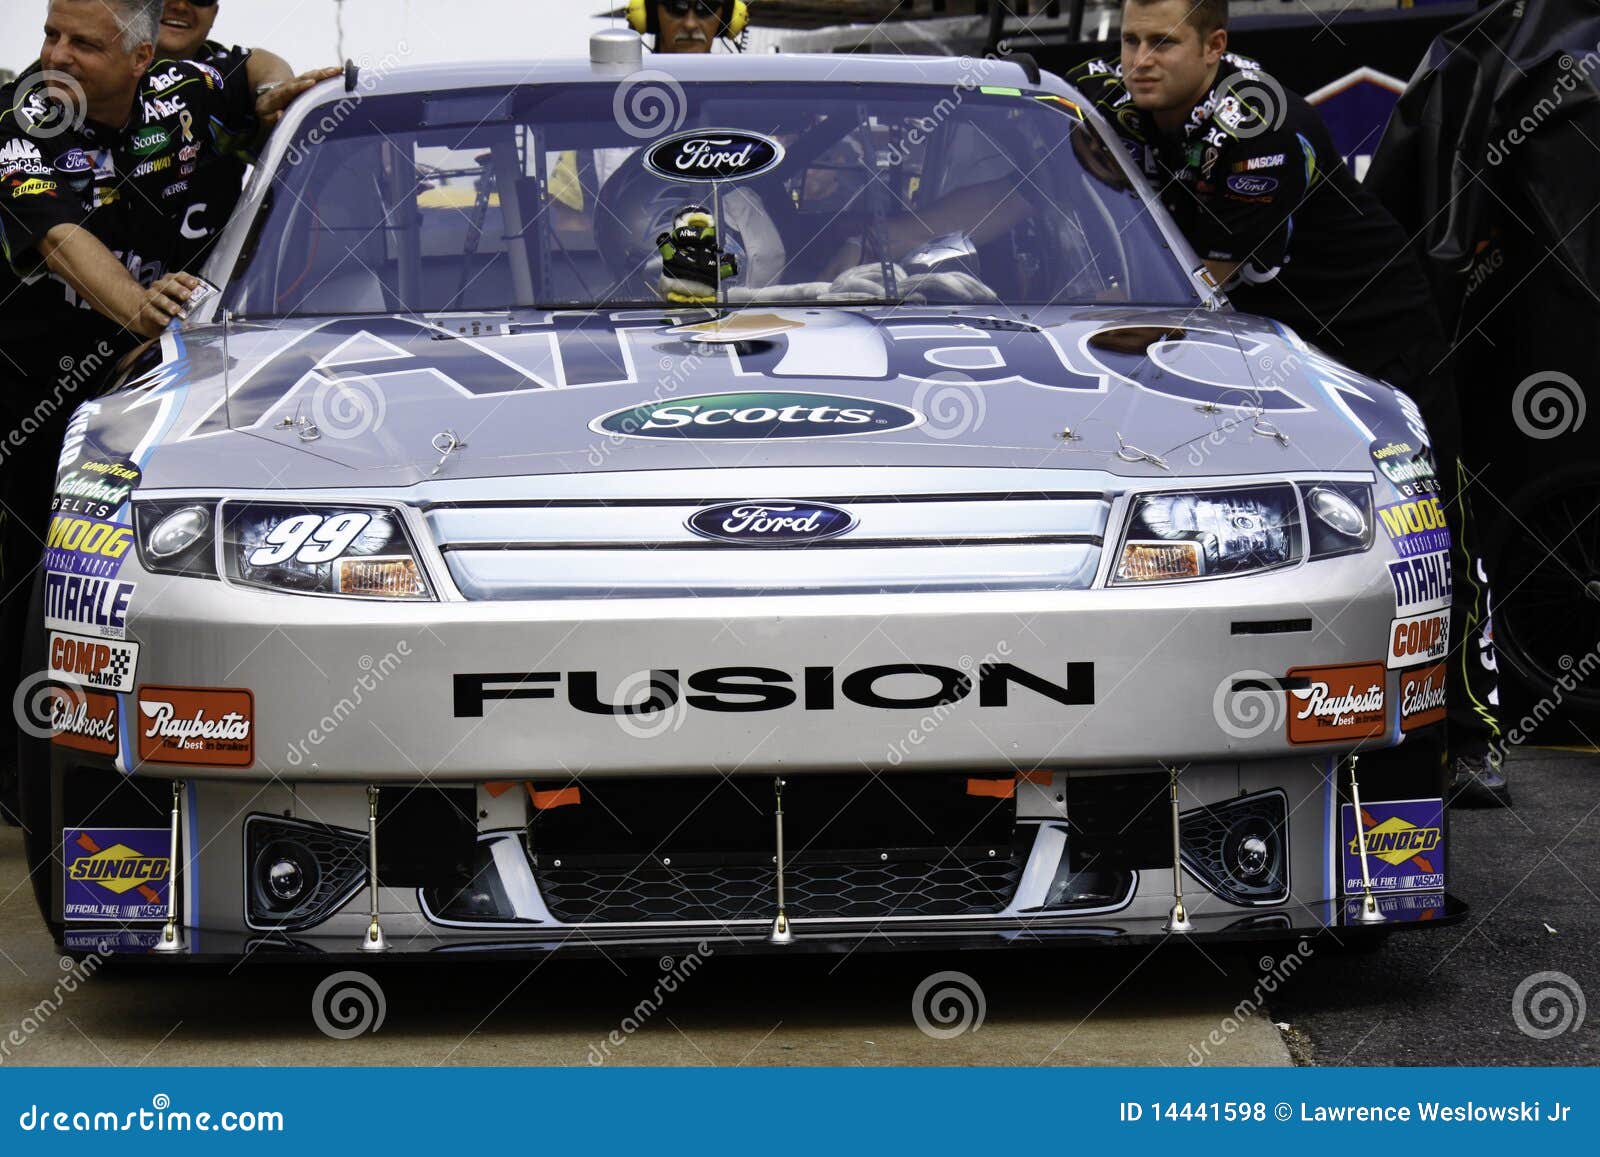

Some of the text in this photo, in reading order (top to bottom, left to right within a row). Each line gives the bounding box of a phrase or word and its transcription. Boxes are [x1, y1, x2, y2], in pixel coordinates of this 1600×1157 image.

[133, 132, 167, 150] Scotts
[133, 154, 173, 178] SUBWAY
[675, 139, 753, 170] Ford
[1247, 153, 1285, 171] NASCAR
[14, 182, 57, 197] SUNOCO
[1234, 176, 1267, 191] Ford
[641, 405, 876, 430] Scotts
[81, 461, 139, 480] GOODYEAR
[1402, 479, 1441, 497] BELTS
[52, 498, 109, 517] BELTS
[722, 506, 823, 533] Ford
[1378, 497, 1447, 539] MOOG
[47, 516, 133, 558] MOOG
[249, 512, 372, 566] 99
[1388, 551, 1452, 607] MAHLE
[45, 572, 135, 628] MAHLE
[1393, 616, 1441, 658] COMP
[1427, 640, 1446, 658] CAMS
[51, 637, 111, 676] COMP
[88, 671, 122, 688] CAMS
[453, 661, 1095, 718] FUSION
[1291, 682, 1384, 726] Raybestos
[51, 696, 115, 742] Edelbrock
[139, 700, 251, 748] Raybestos
[1338, 714, 1355, 726] best
[184, 739, 203, 750] best
[1353, 829, 1437, 853] SUNOCO
[73, 859, 166, 879] SUNOCO
[1380, 877, 1398, 886] FUEL
[65, 903, 168, 918] OFFICIAL FUEL NASCA
